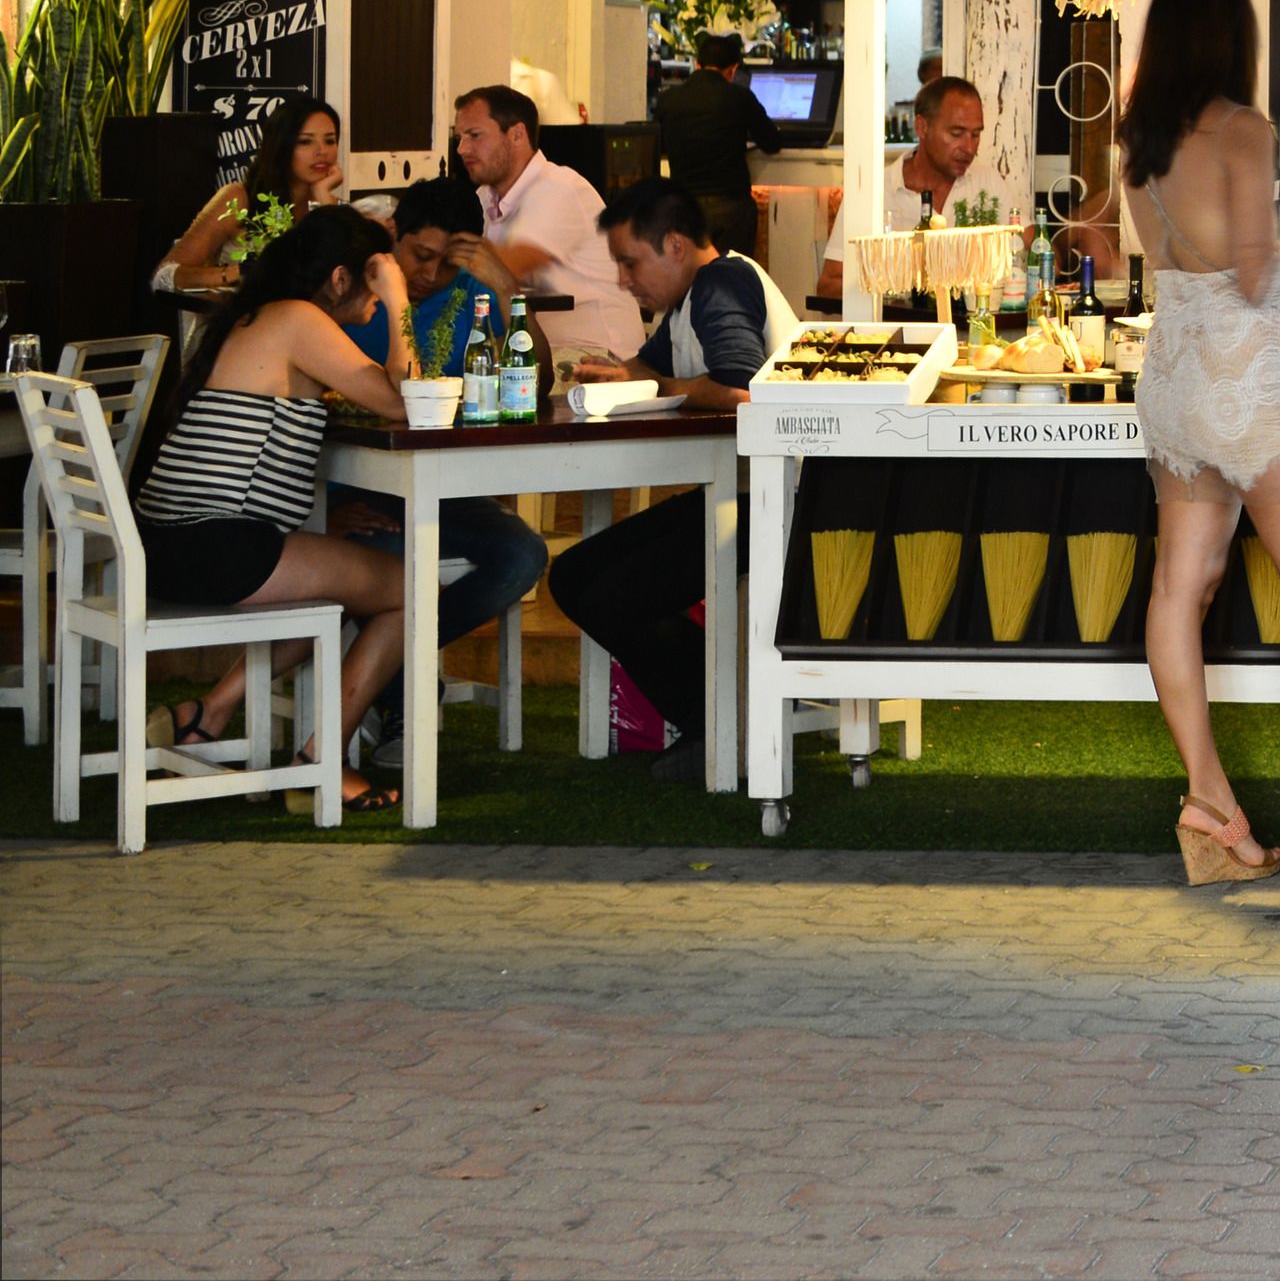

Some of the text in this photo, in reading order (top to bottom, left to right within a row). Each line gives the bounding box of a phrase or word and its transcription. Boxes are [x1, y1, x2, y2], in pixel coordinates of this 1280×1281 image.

[775, 417, 841, 435] AMBASCIATA
[959, 425, 980, 443] IL
[984, 424, 1037, 443] VERO
[1043, 423, 1120, 442] SAPORE
